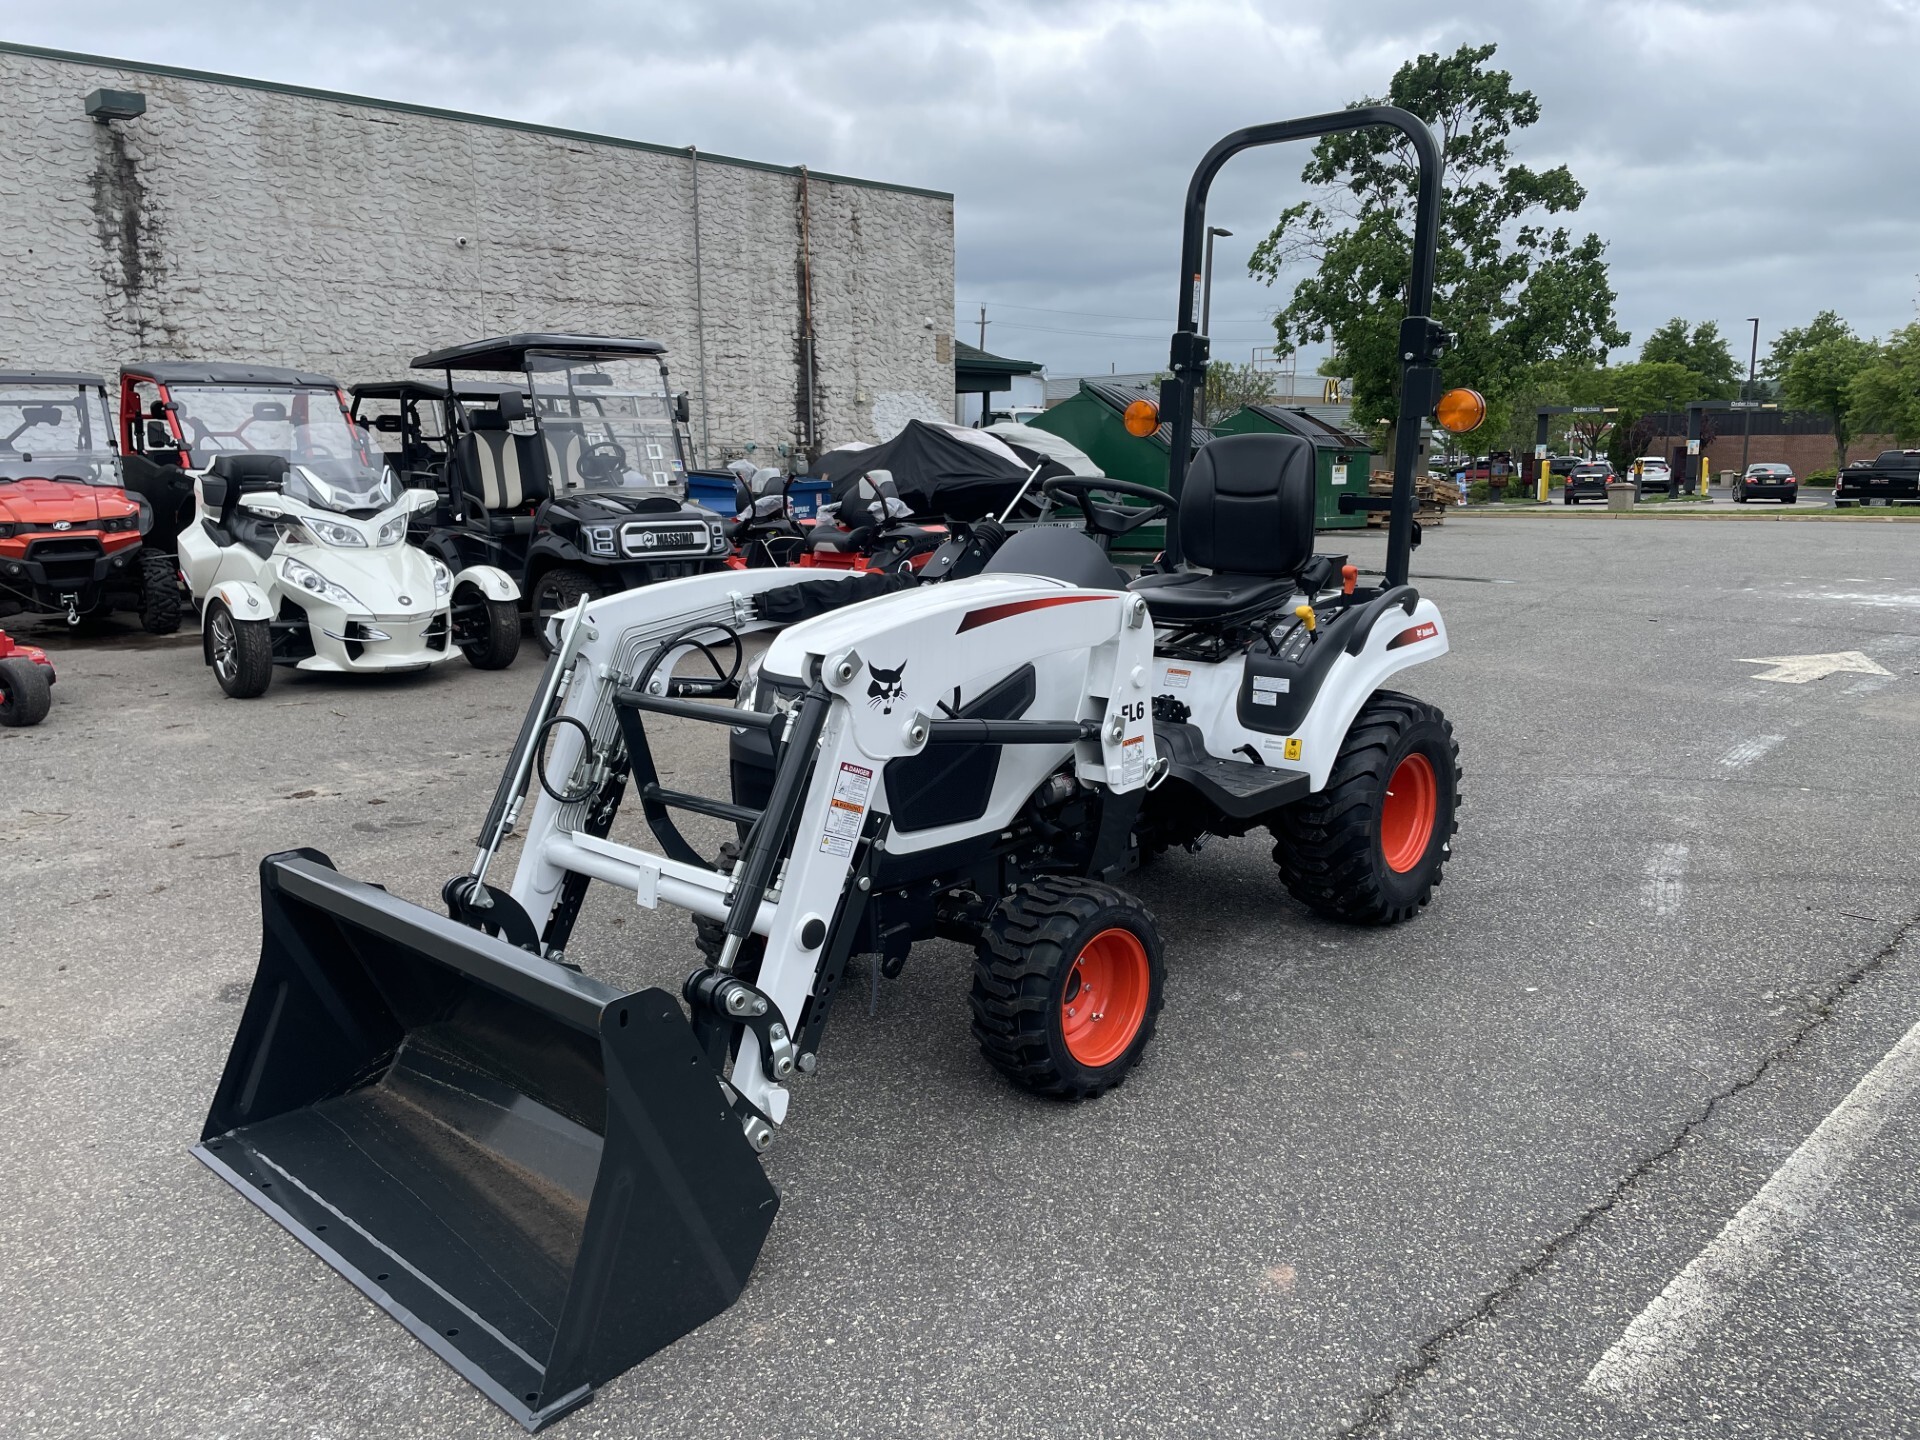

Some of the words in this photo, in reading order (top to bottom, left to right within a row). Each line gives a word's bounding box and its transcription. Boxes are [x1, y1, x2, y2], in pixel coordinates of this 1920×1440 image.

[656, 532, 695, 546] MASSIMO
[1121, 701, 1145, 722] FL6
[848, 765, 870, 777] DANGER
